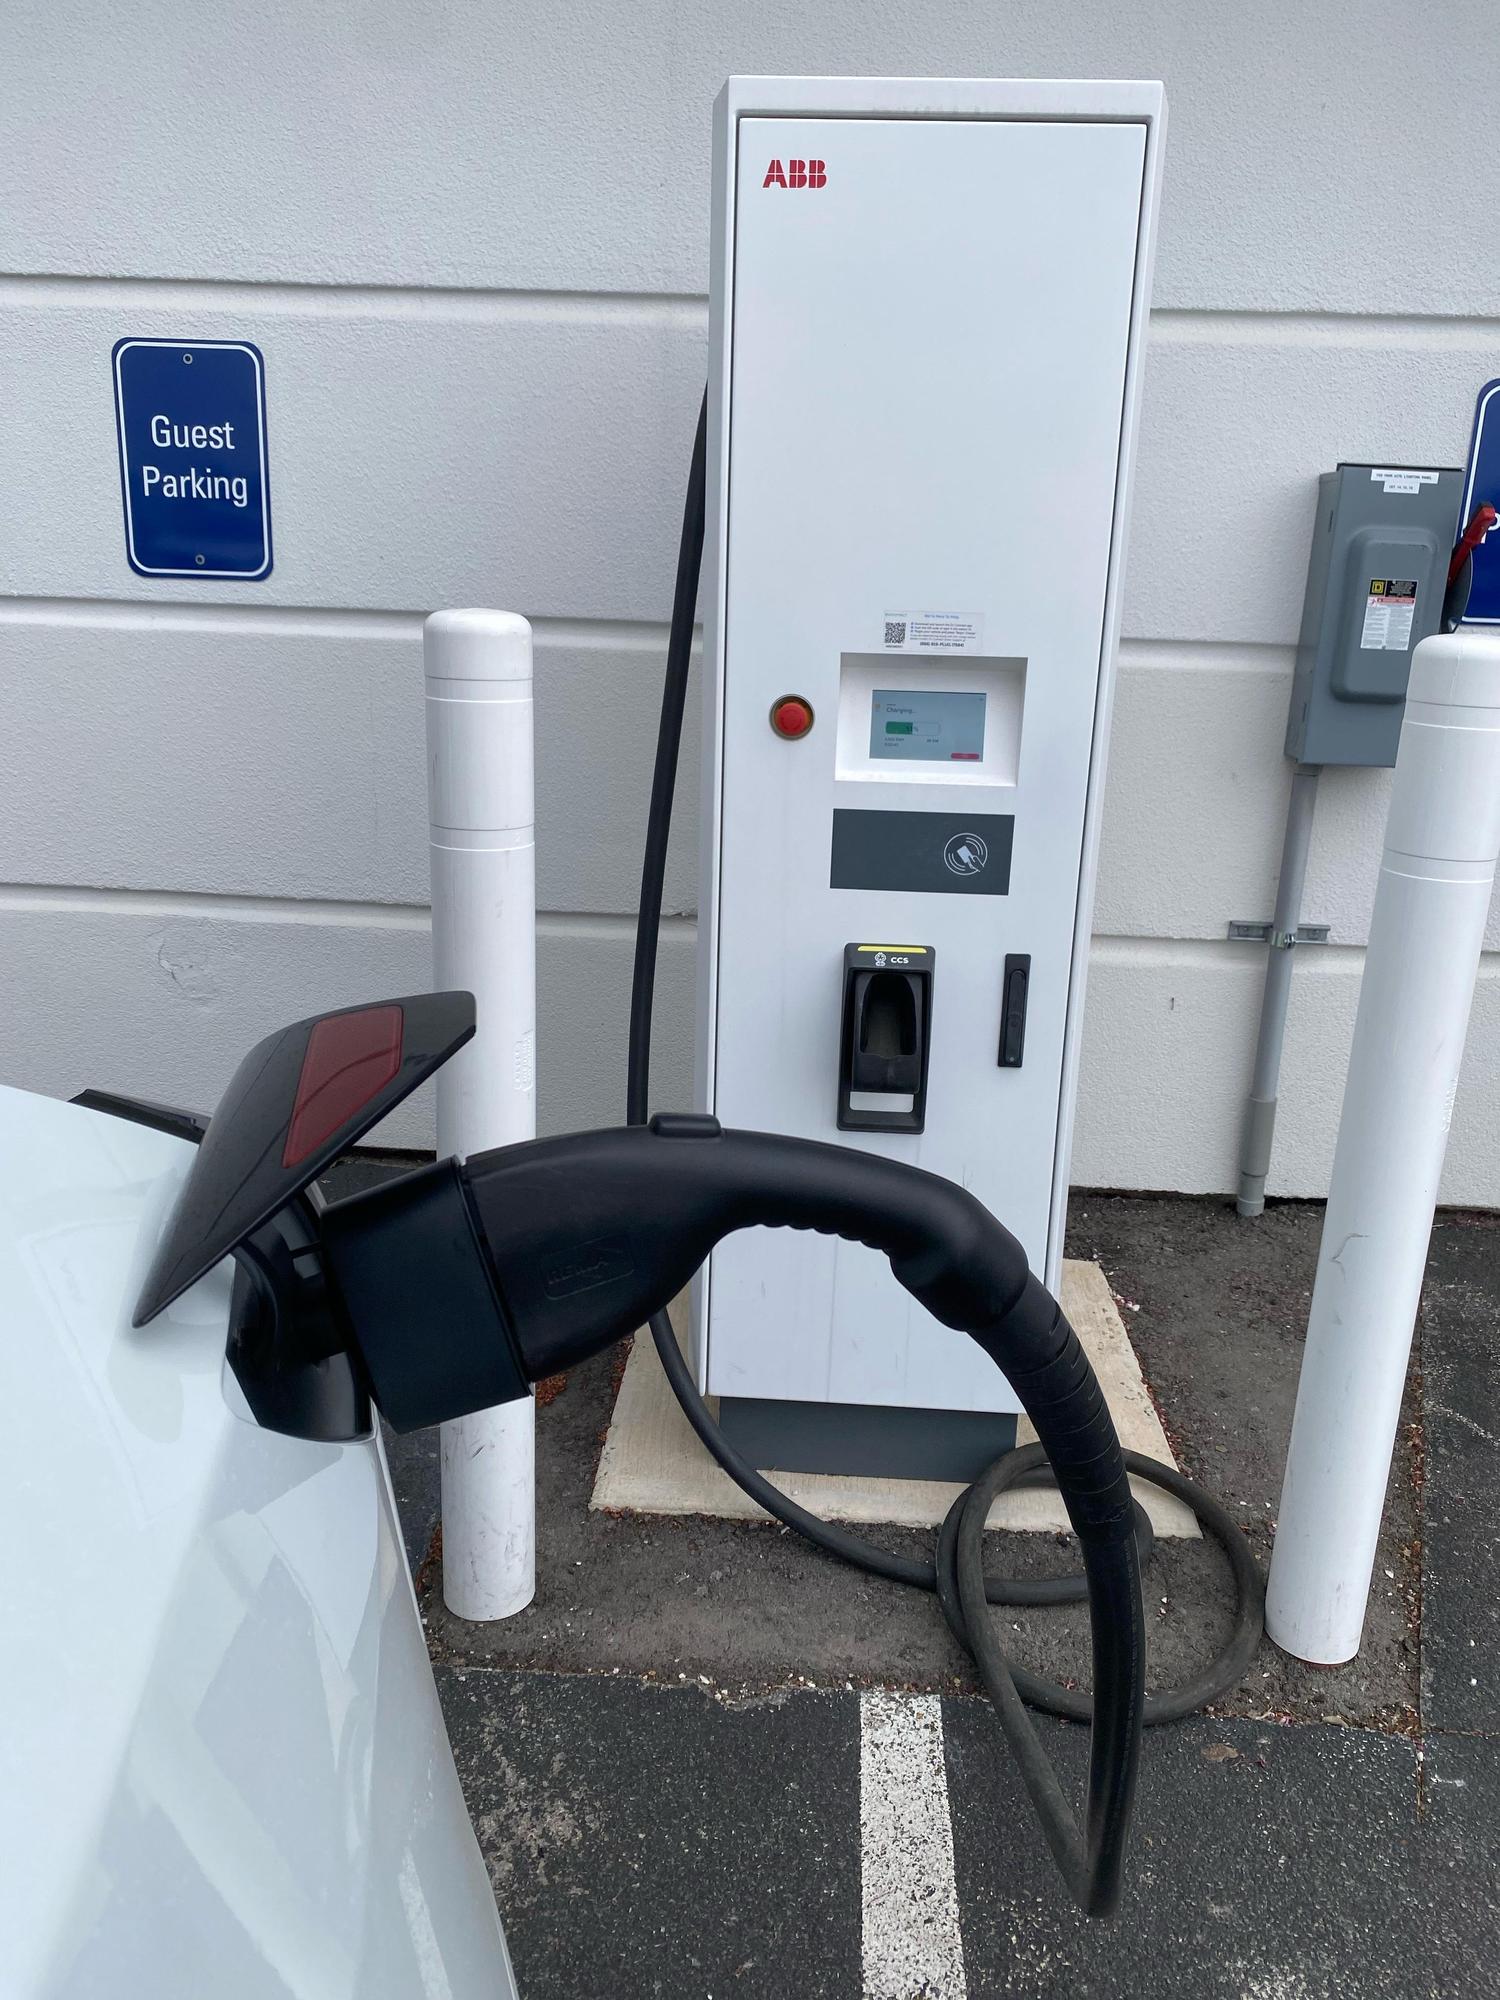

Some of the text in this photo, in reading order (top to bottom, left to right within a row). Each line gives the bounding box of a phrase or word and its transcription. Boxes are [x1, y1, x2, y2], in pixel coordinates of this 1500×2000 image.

[762, 160, 827, 188] ABB
[151, 415, 235, 450] Guest
[142, 466, 248, 507] Parking
[890, 956, 909, 964] CCS
